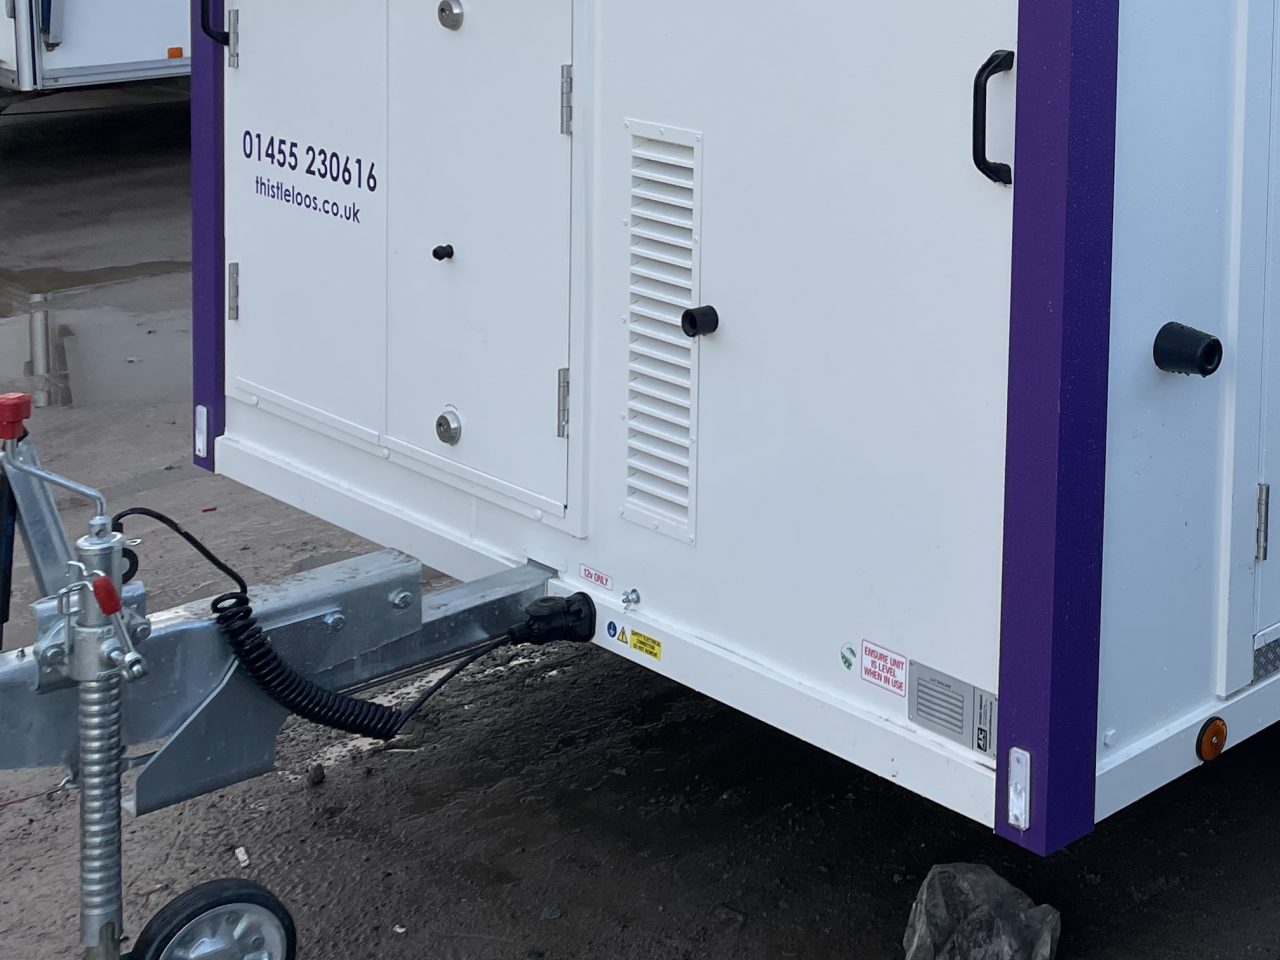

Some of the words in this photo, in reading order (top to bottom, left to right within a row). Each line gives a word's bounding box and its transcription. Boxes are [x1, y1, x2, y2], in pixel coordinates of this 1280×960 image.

[242, 130, 298, 171] 01455
[305, 145, 377, 192] 230616
[255, 175, 361, 224] thistleloos.co.uk
[594, 572, 609, 587] ONLY
[864, 646, 889, 665] ENSURE
[889, 656, 905, 671] UNIT
[870, 659, 878, 670] IS
[878, 662, 897, 679] LEVEL
[863, 666, 883, 682] WHEN
[883, 674, 891, 686] IN
[891, 678, 904, 692] USE
